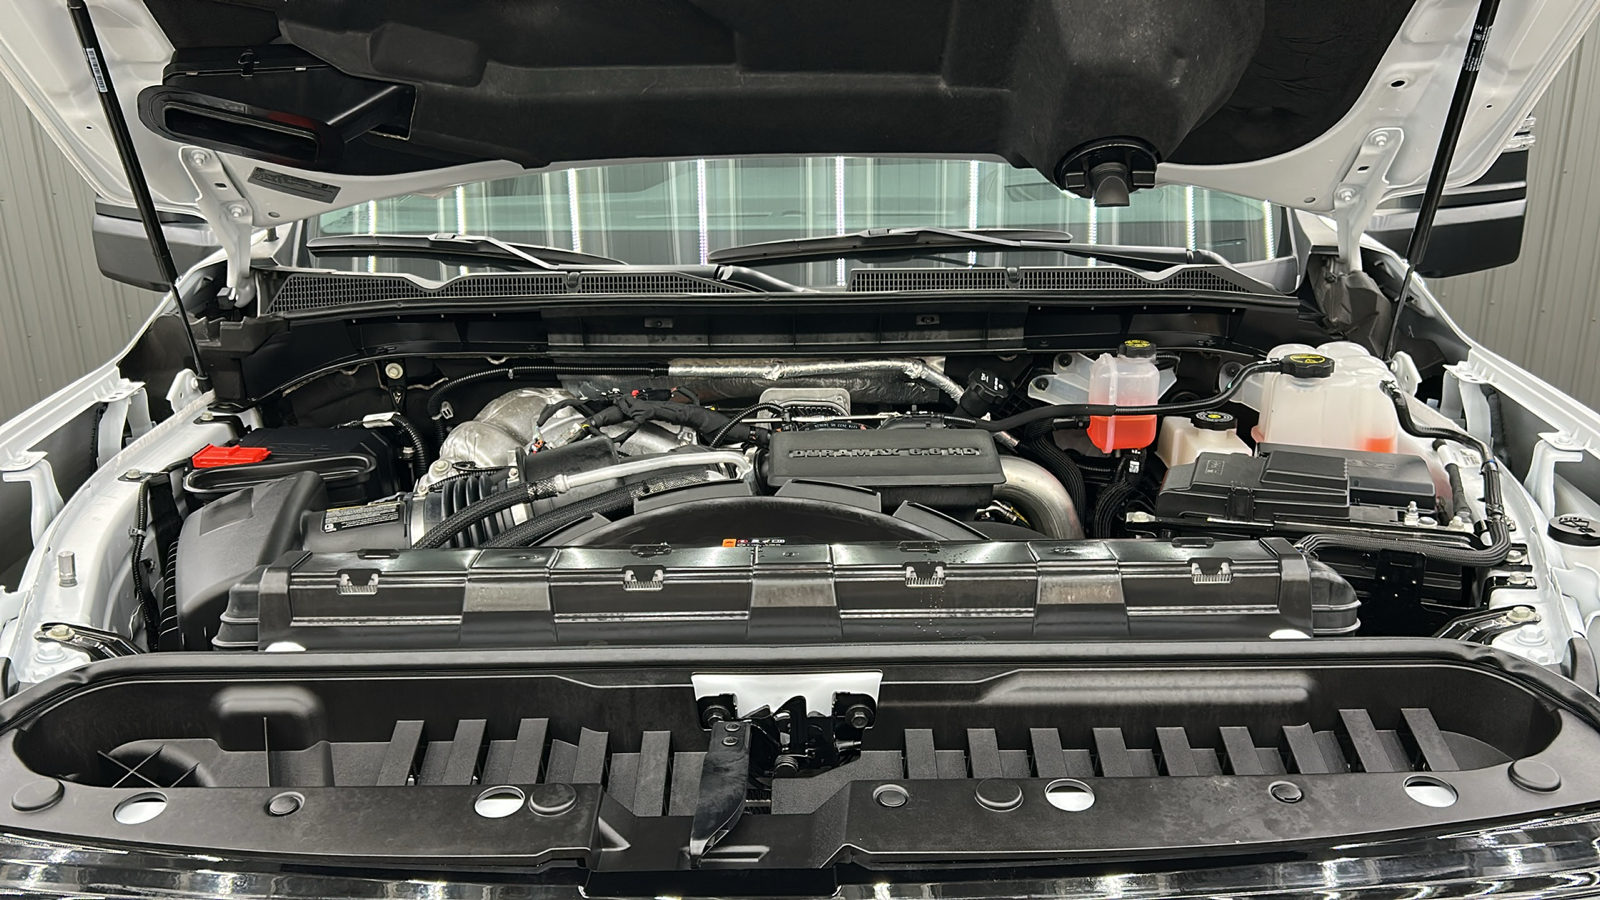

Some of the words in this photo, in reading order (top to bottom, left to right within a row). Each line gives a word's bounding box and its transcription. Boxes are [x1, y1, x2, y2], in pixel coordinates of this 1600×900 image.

[789, 448, 901, 458] DURAMAX
[908, 447, 944, 457] 6.6
[946, 447, 981, 456] HD
